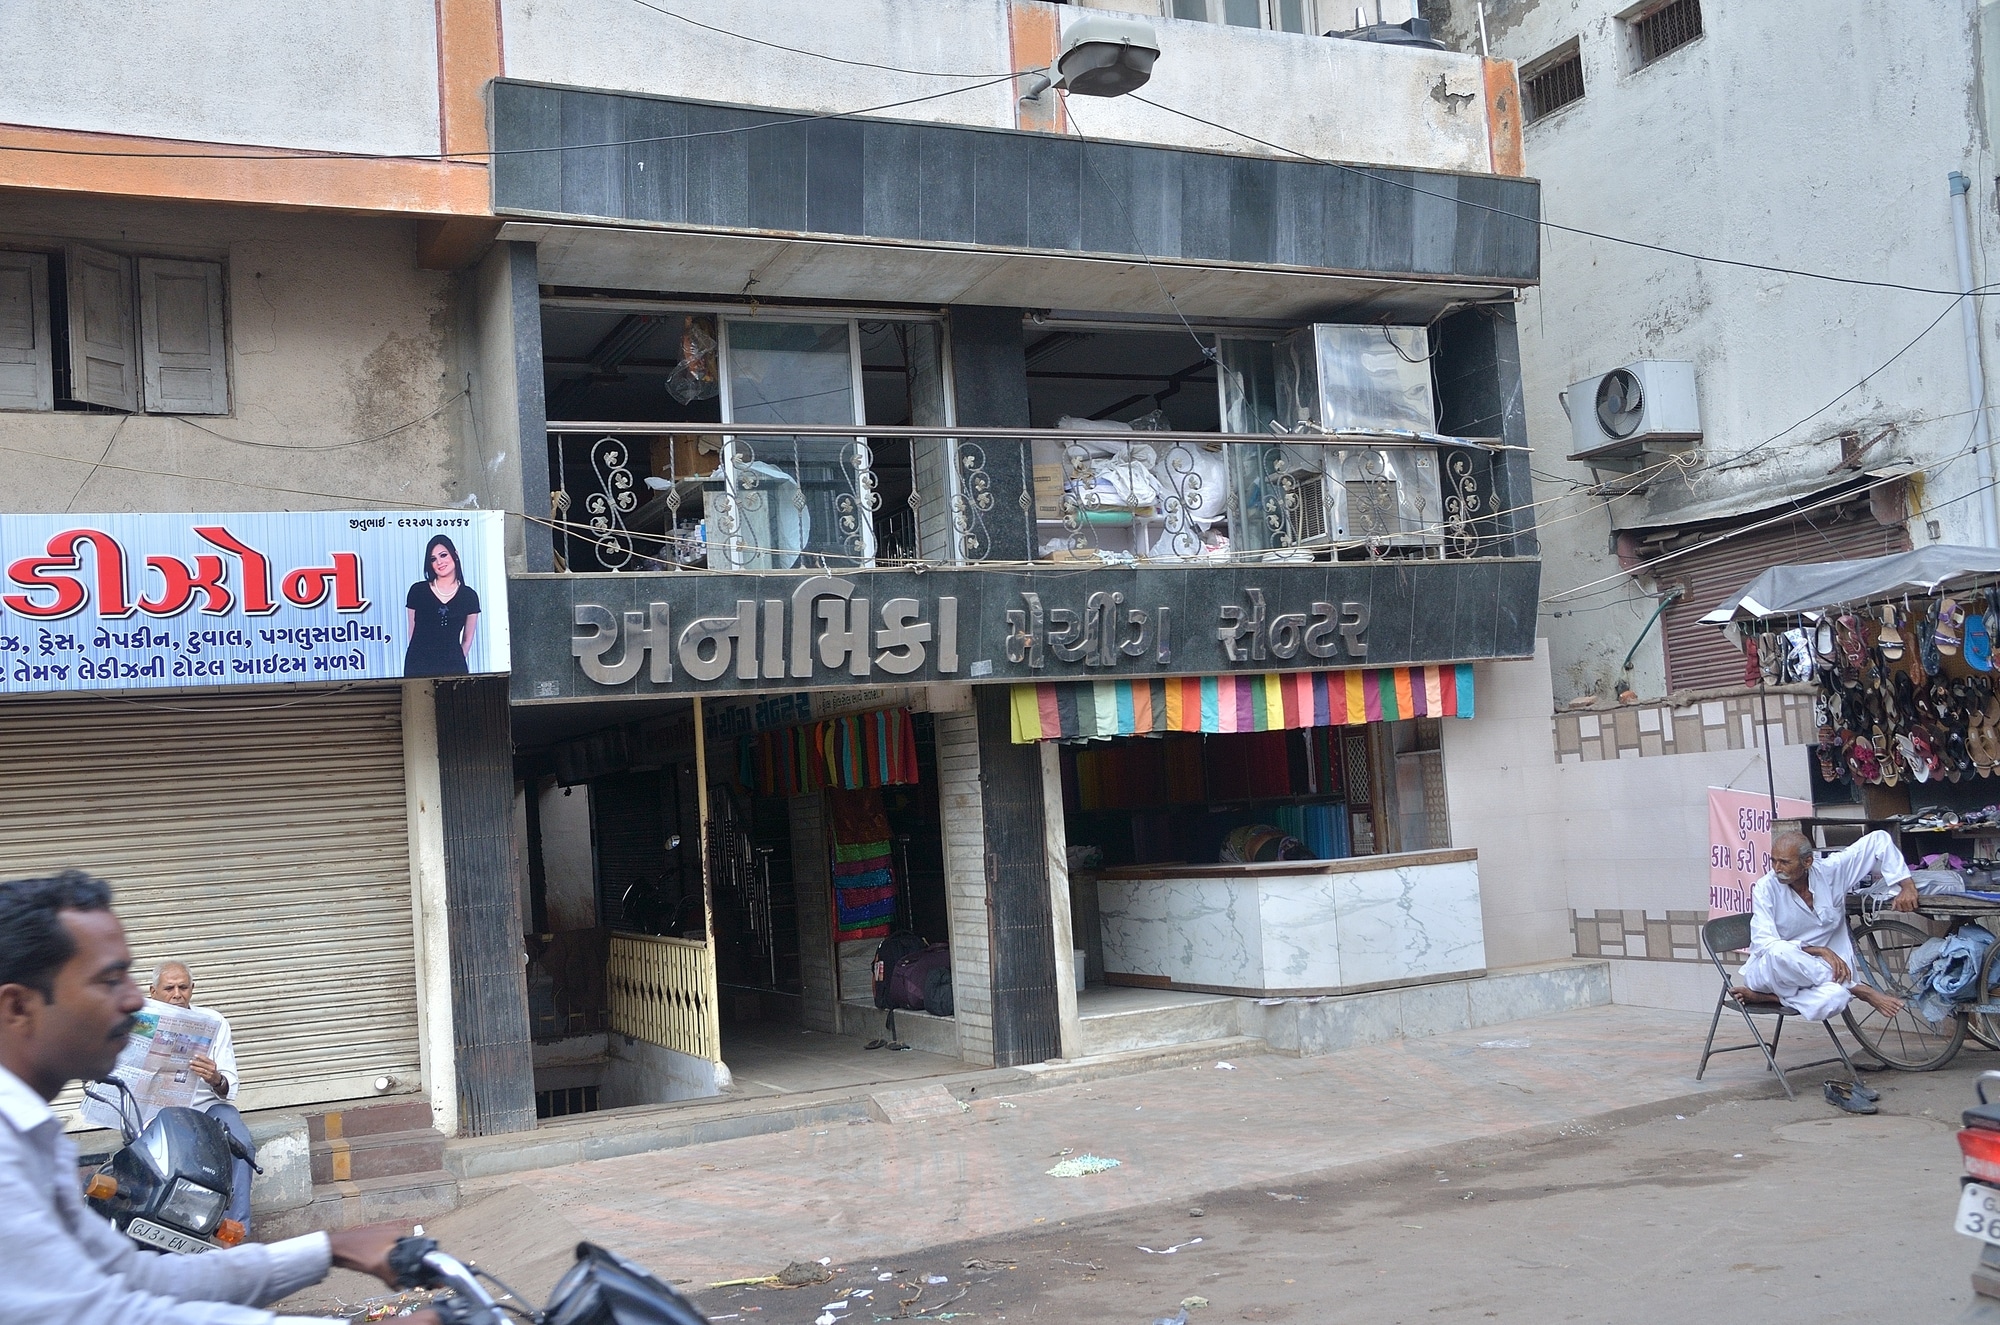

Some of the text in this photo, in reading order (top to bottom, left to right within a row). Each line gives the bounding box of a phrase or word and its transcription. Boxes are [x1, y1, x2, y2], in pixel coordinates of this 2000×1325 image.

[93, 625, 180, 650] નેપકીન,
[187, 629, 252, 654] ટુવાલ,
[572, 576, 958, 685] અનામિકા
[1005, 587, 1371, 668] મેચીંગ સેન્ટર
[13, 658, 70, 682] તેમજ
[78, 656, 165, 679] લેડીઝની
[173, 654, 225, 677] ટોટલ
[314, 648, 365, 671] મળશે
[1711, 845, 1732, 869] કામ
[1737, 840, 1756, 873] કરી
[1983, 1196, 2000, 1213] G
